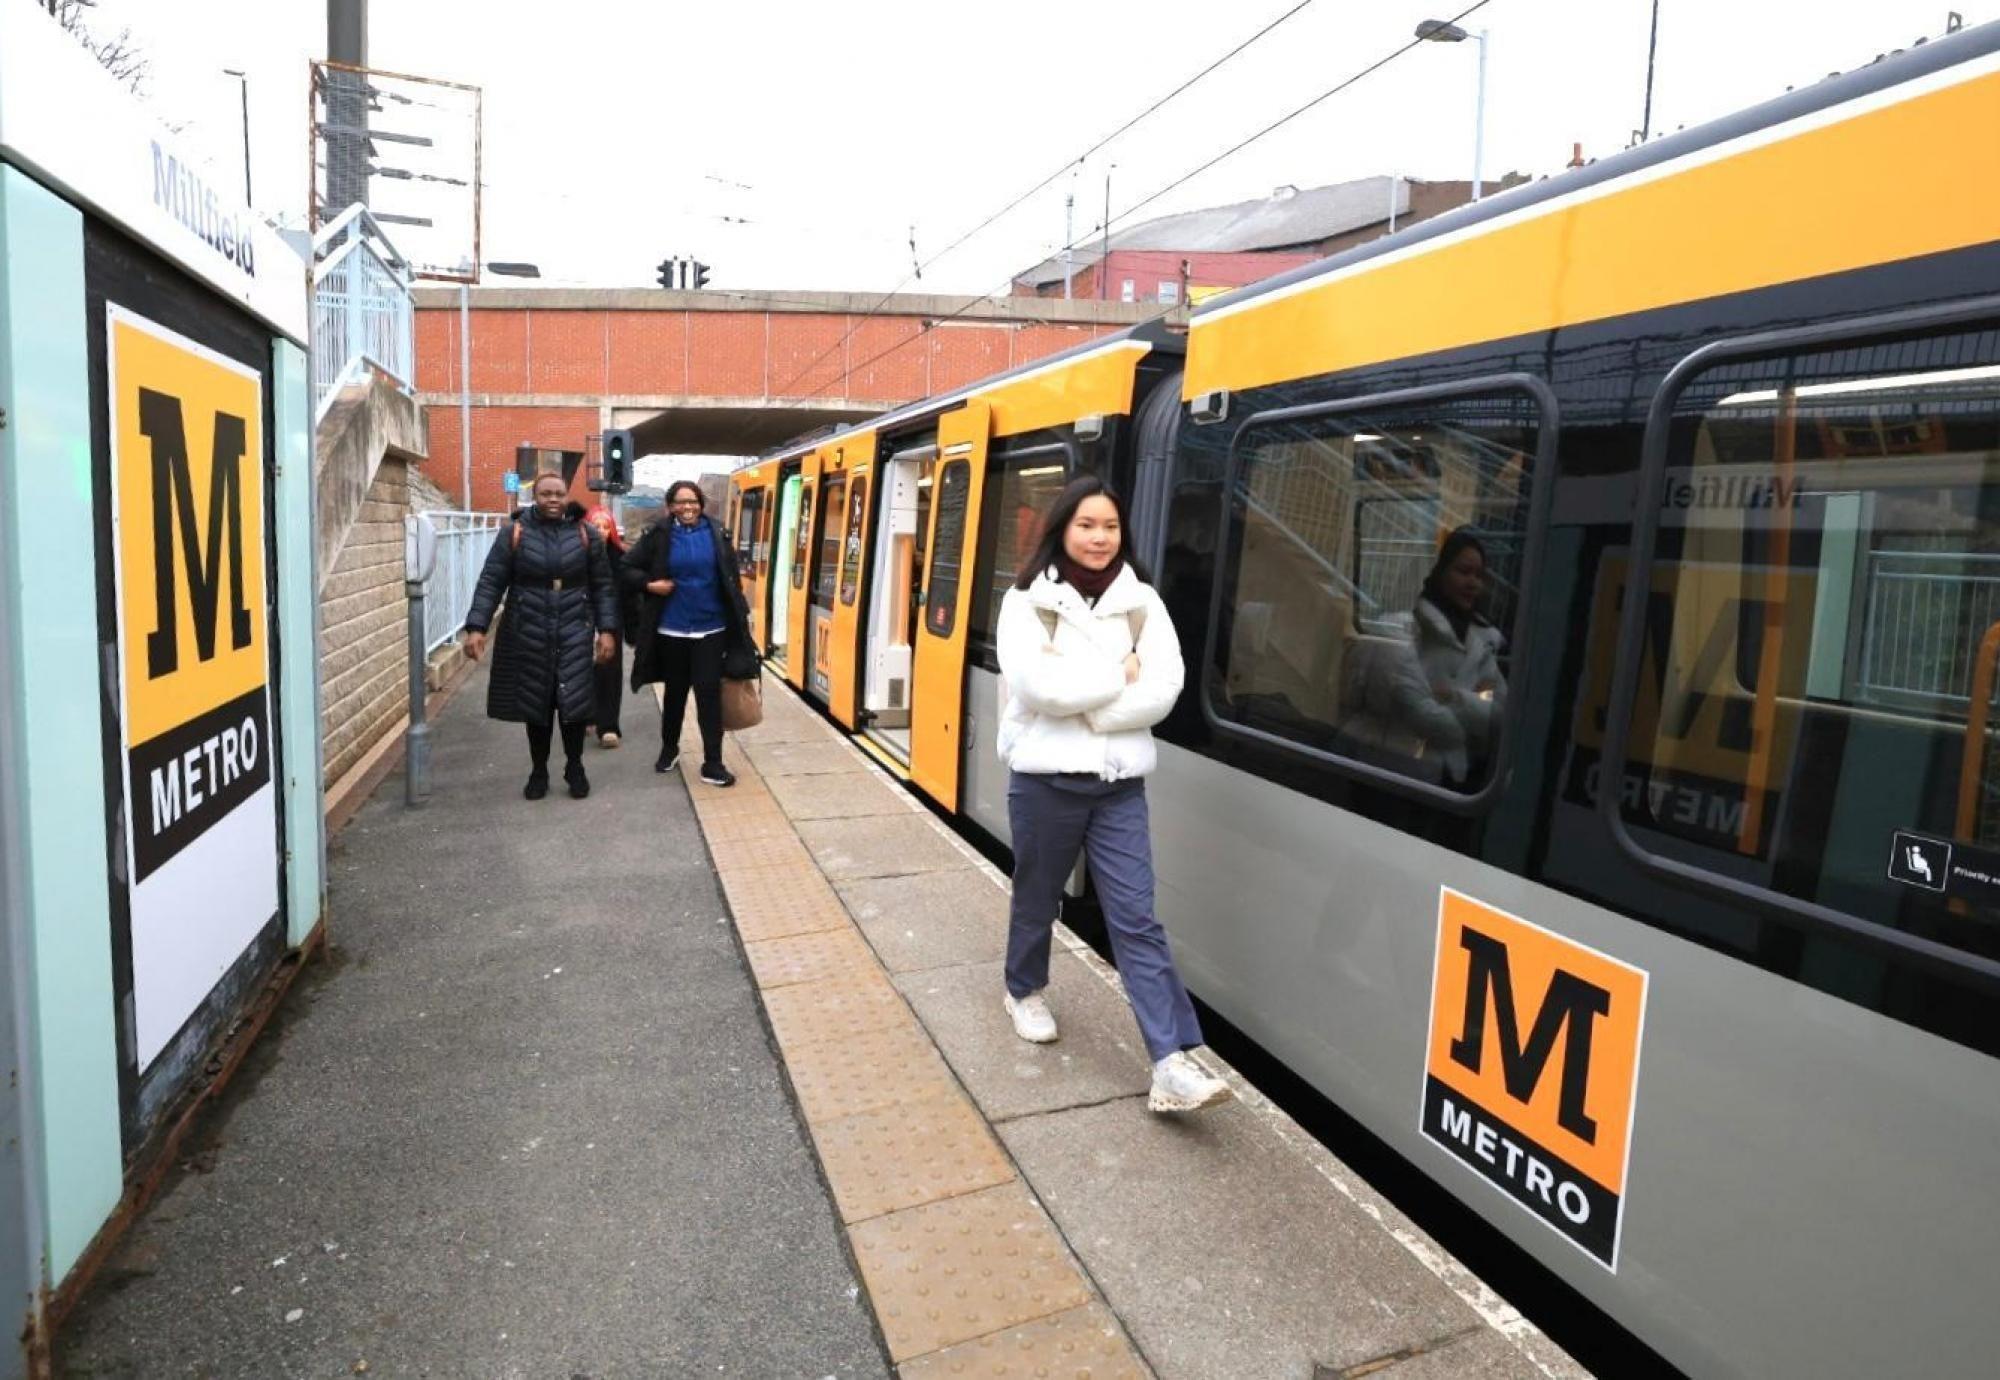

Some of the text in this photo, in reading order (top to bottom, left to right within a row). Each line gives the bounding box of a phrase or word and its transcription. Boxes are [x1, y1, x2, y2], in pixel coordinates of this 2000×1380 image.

[150, 139, 255, 279] Millfield
[138, 385, 252, 681] M
[150, 716, 258, 836] METRO
[1450, 924, 1611, 1147] M
[1440, 1099, 1591, 1225] METRO
